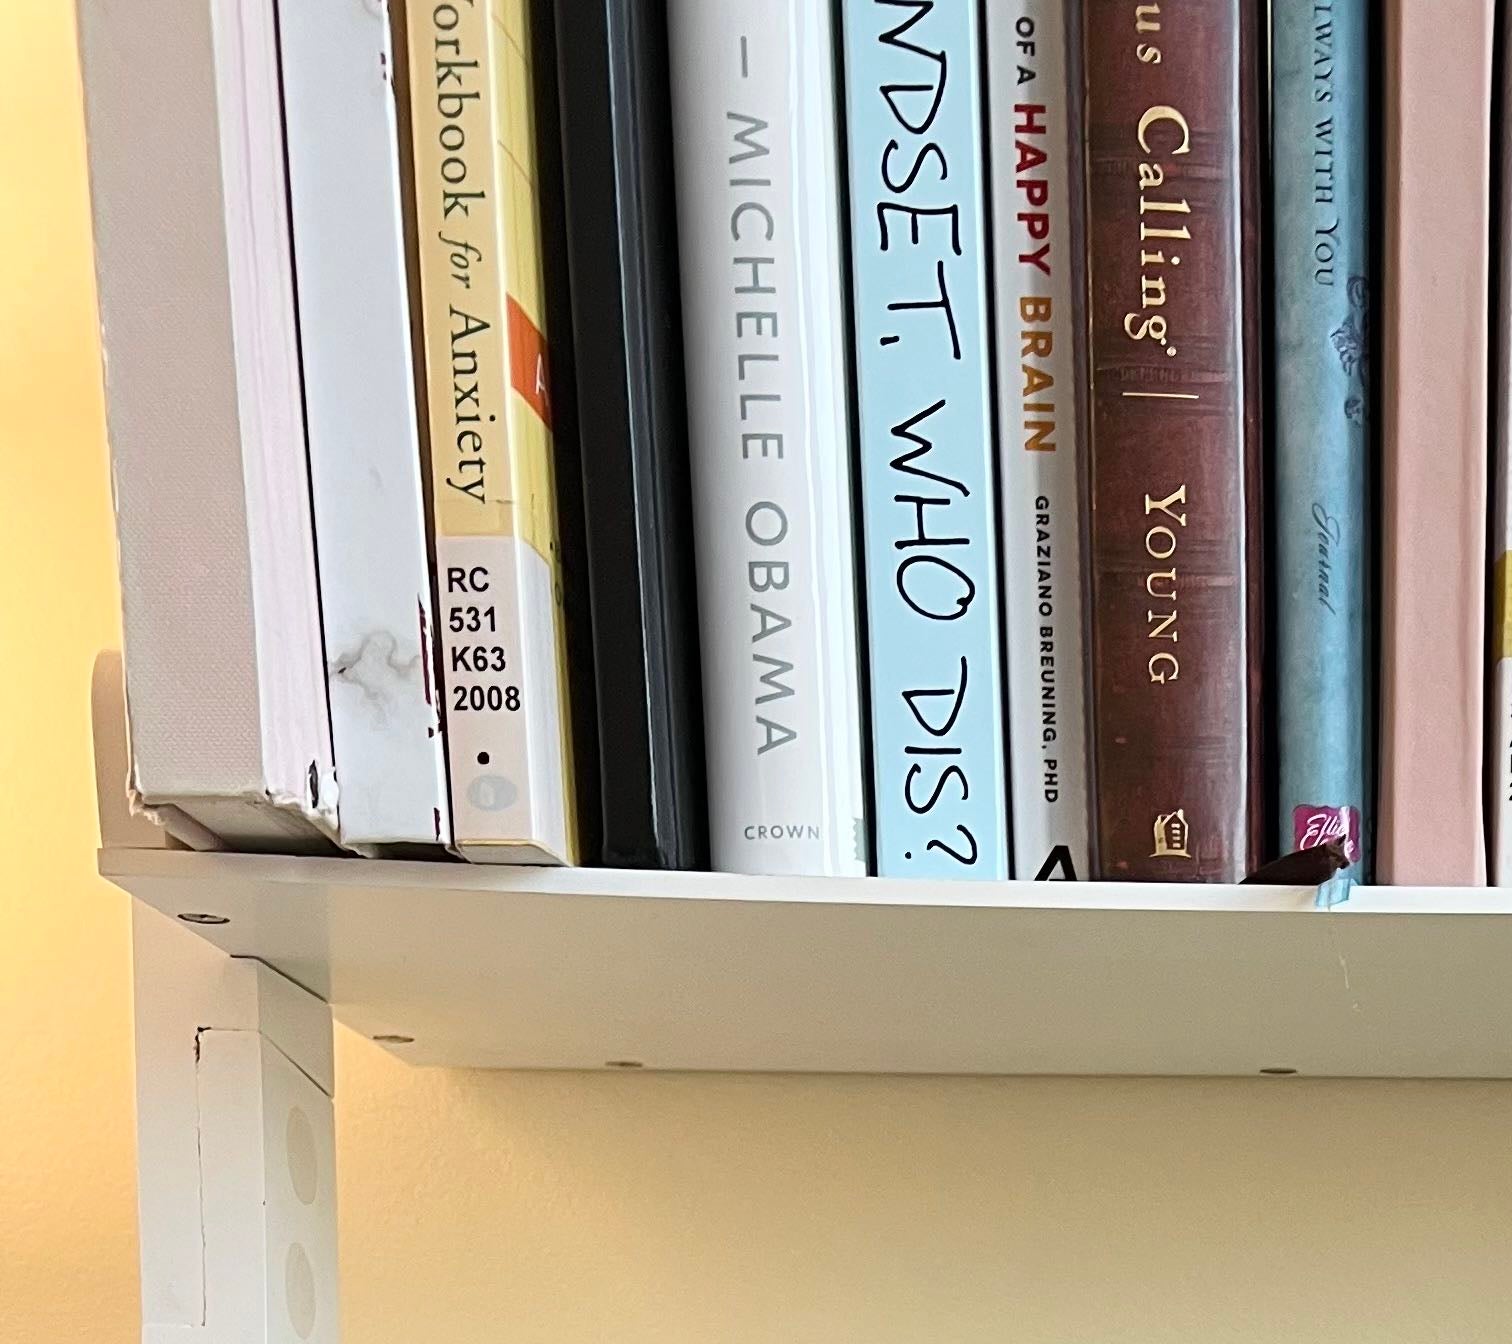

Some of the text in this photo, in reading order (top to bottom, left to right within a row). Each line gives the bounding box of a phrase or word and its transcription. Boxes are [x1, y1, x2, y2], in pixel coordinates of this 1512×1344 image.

[1135, 3, 1162, 65] us
[1314, 117, 1334, 204] WITH
[433, 0, 496, 505] orkbook for Anxiety
[1014, 16, 1057, 452] OF A HAPPY BRAIN
[1314, 218, 1340, 286] YOU
[726, 111, 797, 756] MICHELLE OBAMA
[890, 398, 976, 621] WHO
[1312, 502, 1341, 616] Journal
[447, 567, 490, 593] RC
[449, 606, 496, 632] 531
[1145, 484, 1187, 685] YOUNG
[452, 646, 506, 672] K63
[453, 685, 521, 712] 2008
[1035, 495, 1060, 803] GRAZIANO BREUNING, PHD
[902, 655, 978, 866] DIS?
[744, 825, 820, 841] CROWN
